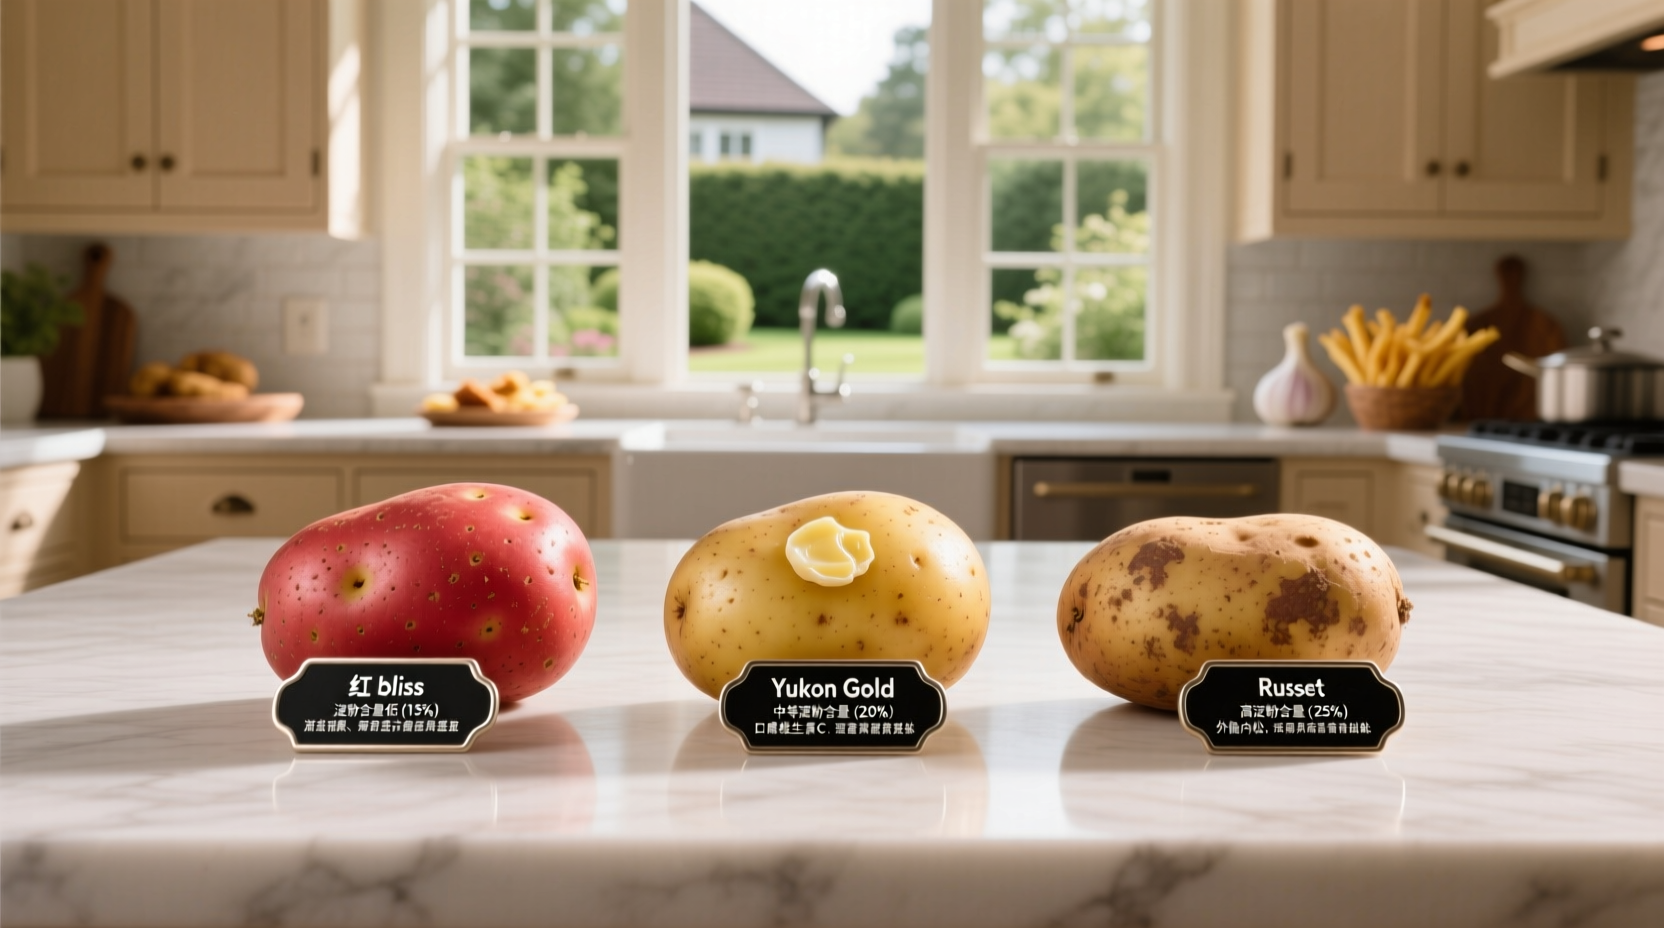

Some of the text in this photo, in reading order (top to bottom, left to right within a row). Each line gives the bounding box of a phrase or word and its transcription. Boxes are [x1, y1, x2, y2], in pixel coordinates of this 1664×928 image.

[348, 674, 424, 697] 红 bliss
[772, 677, 894, 698] Yukon Gold
[1259, 678, 1325, 697] Russet
[854, 705, 893, 719] (20%)
[1308, 705, 1347, 719] (25%)
